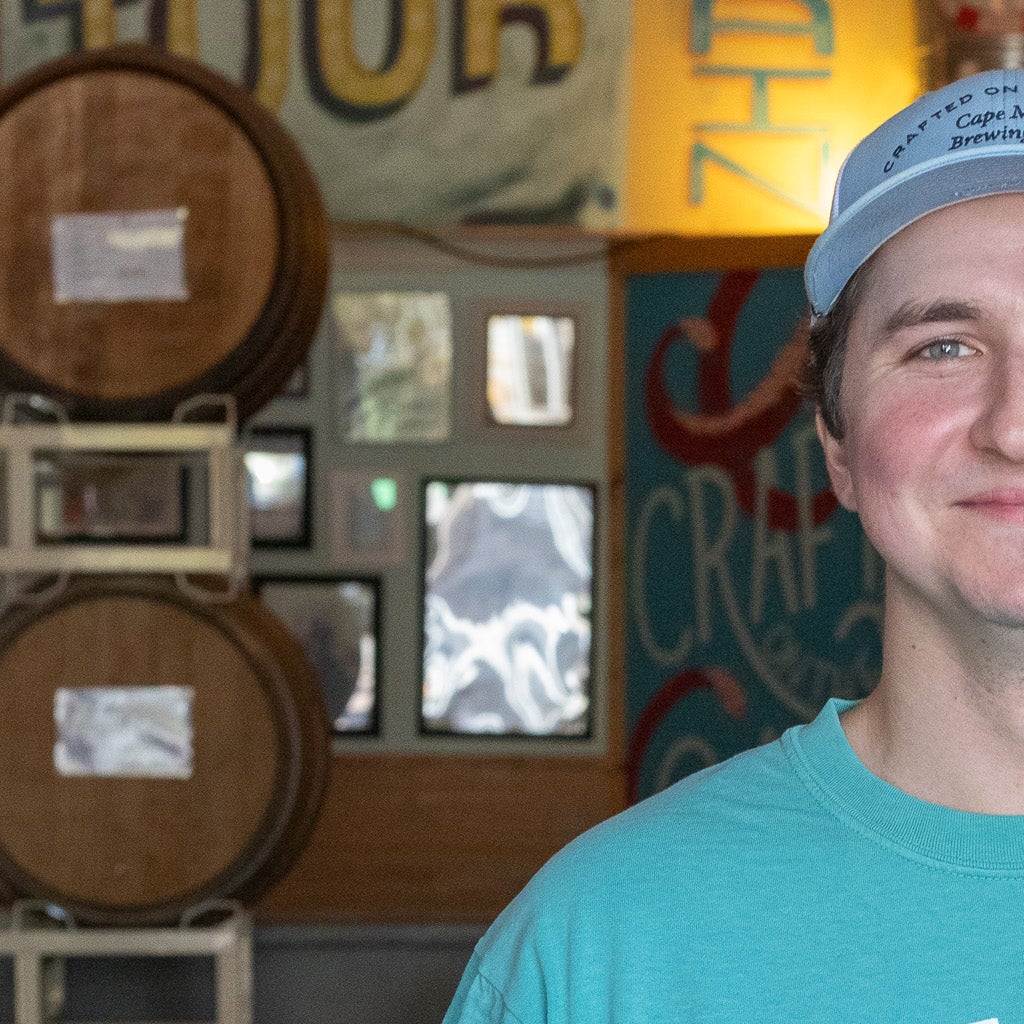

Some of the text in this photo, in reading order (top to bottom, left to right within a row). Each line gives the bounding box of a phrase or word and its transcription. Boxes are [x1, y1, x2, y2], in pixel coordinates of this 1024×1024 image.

[884, 94, 972, 173] CRAFTED
[984, 85, 1018, 96] ON
[955, 110, 1005, 129] Cape
